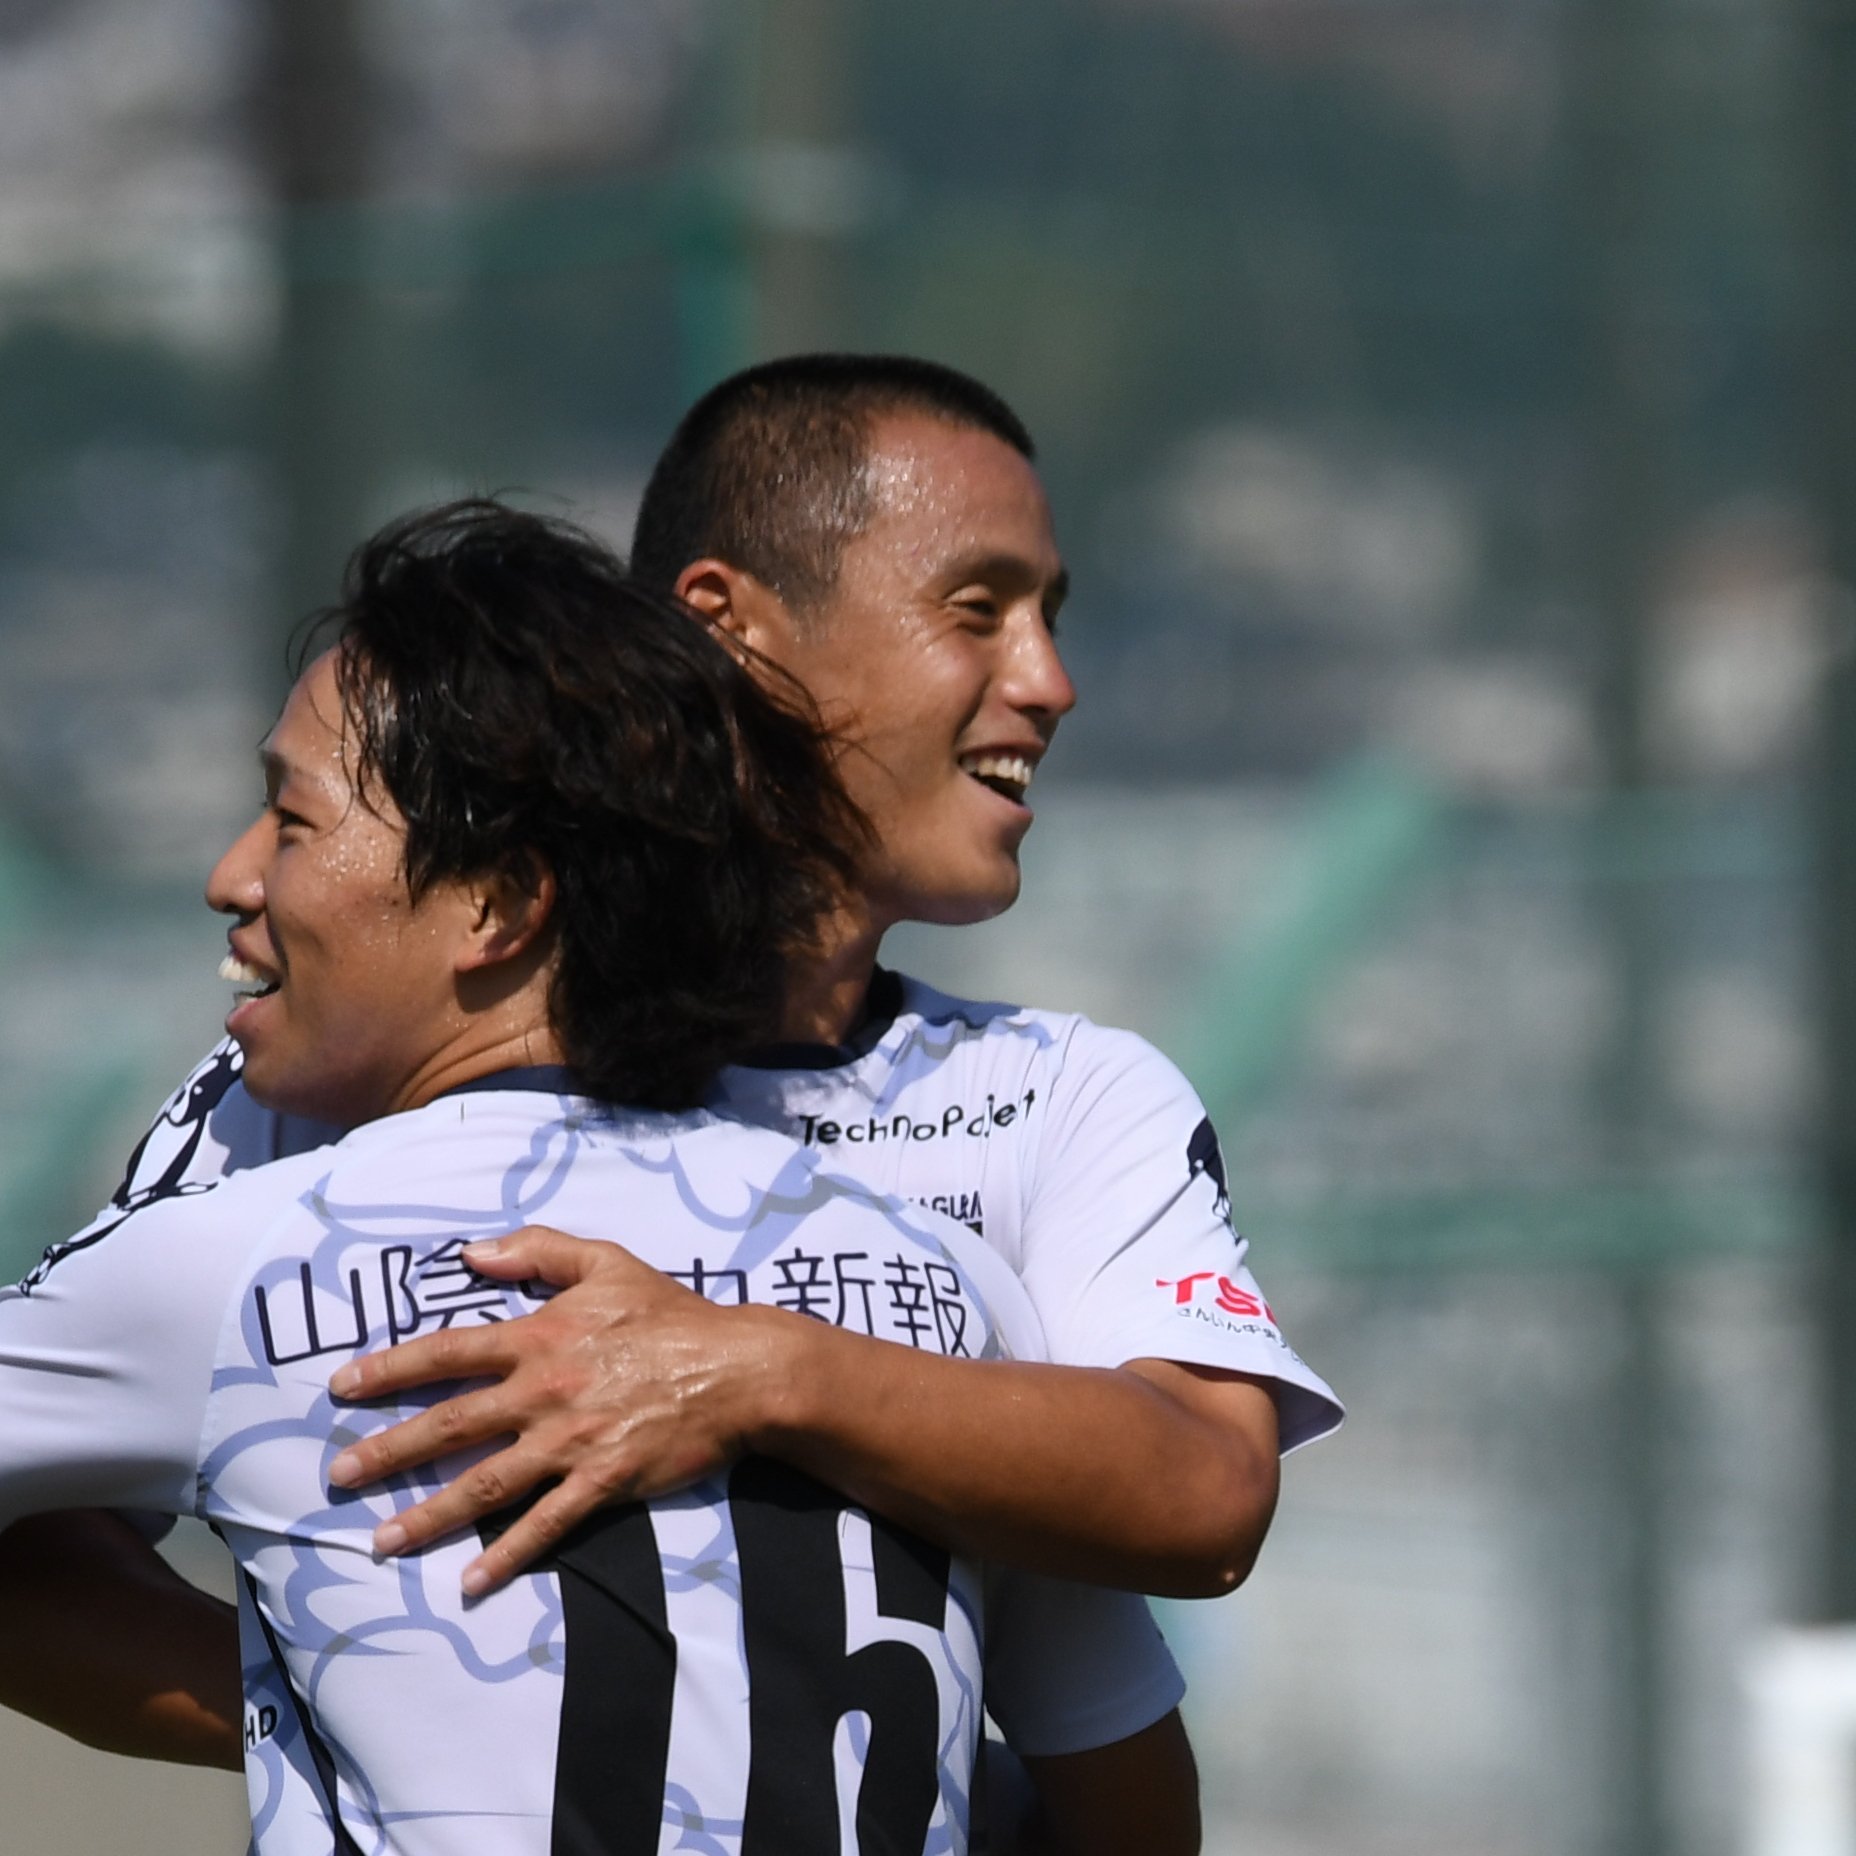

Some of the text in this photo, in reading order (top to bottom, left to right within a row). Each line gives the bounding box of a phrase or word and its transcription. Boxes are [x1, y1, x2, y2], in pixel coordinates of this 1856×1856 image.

[254, 1237, 970, 1366] 山陰新報
[1155, 1266, 1277, 1326] TS
